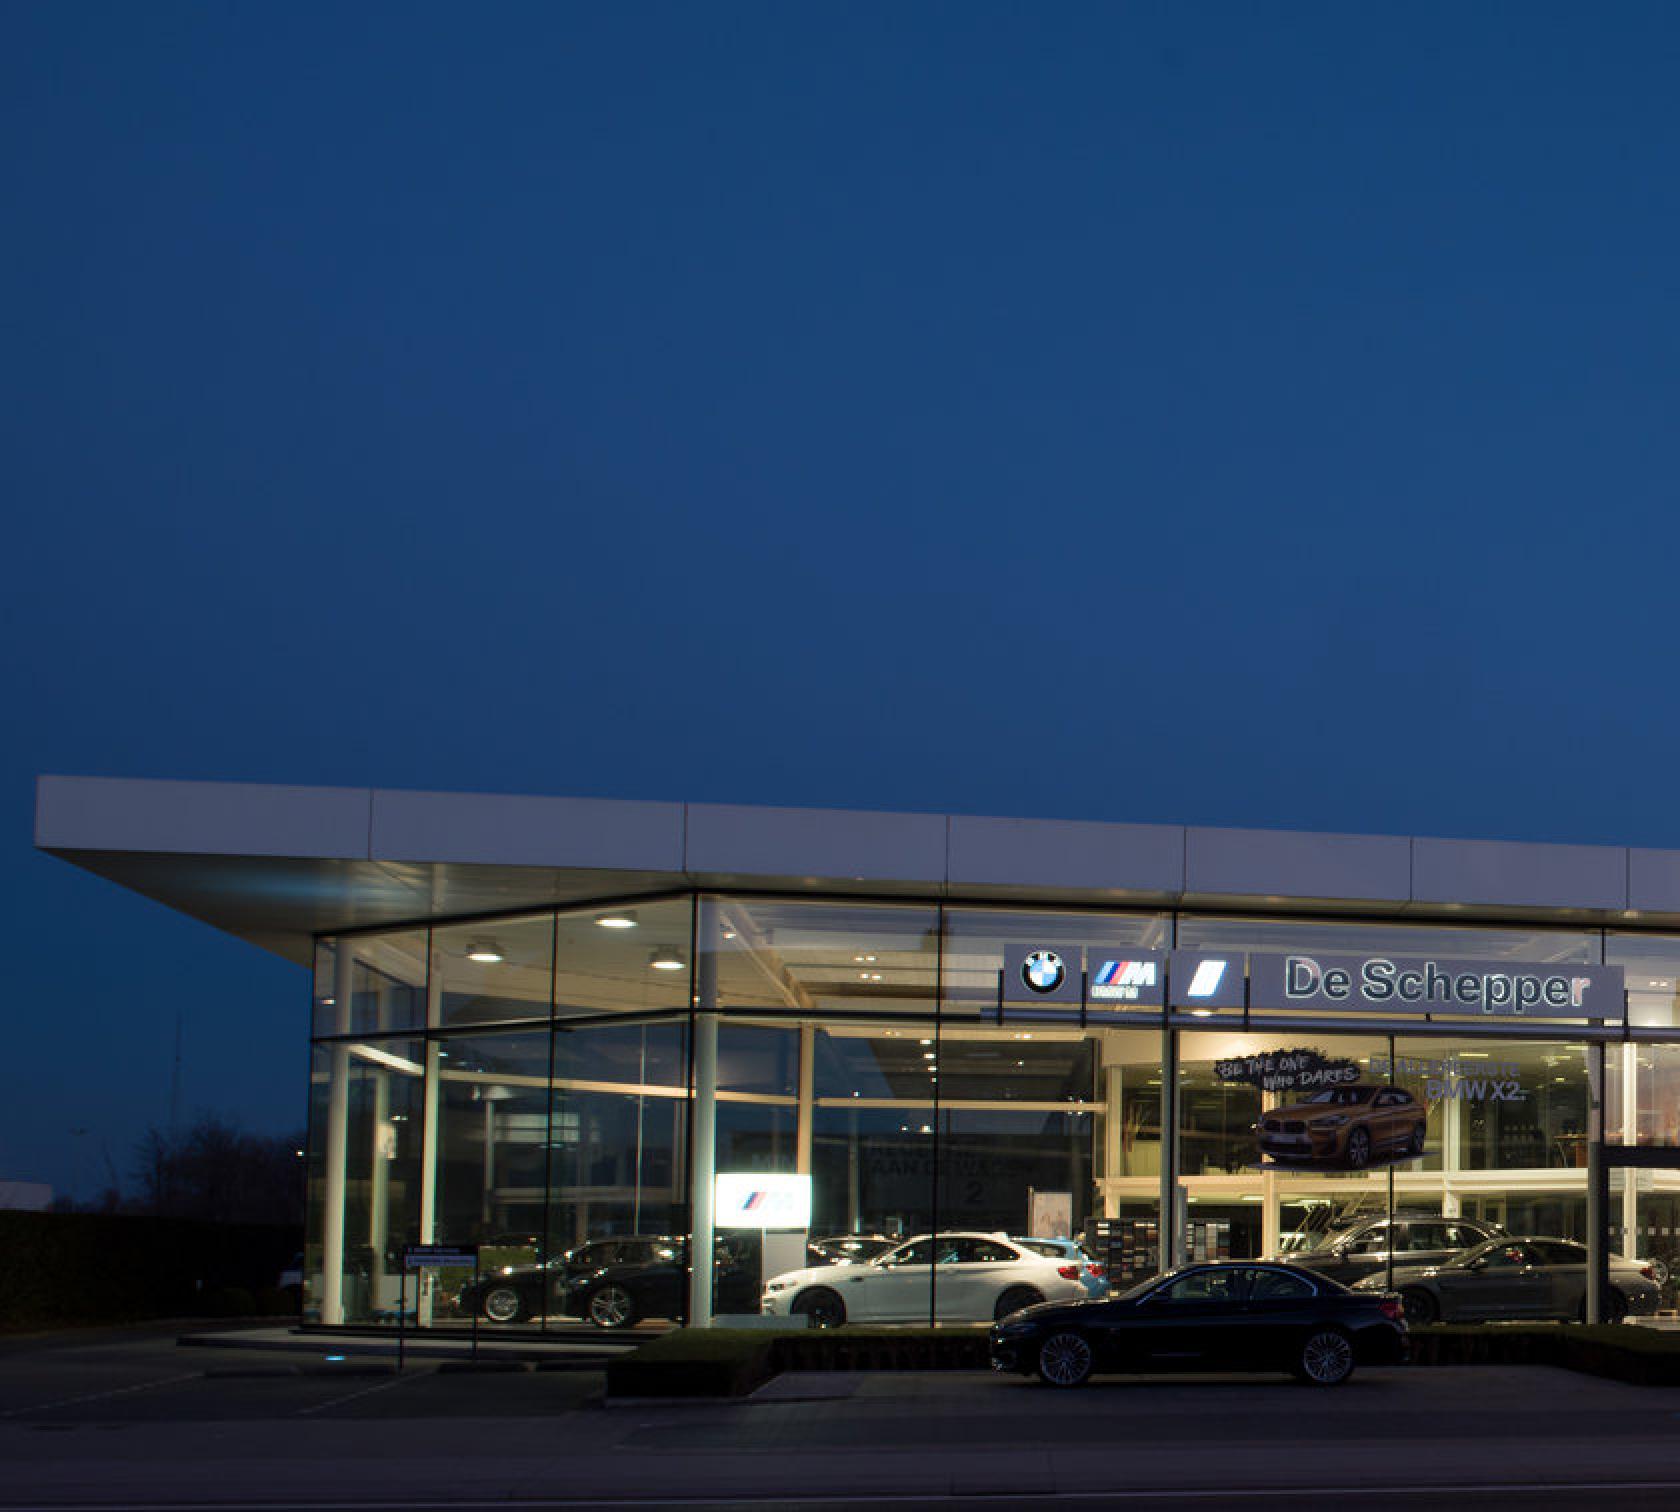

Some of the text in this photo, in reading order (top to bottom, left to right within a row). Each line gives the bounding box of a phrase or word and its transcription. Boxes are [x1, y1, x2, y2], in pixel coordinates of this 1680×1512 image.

[1285, 956, 1592, 1014] De Schepper
[1218, 1055, 1310, 1077] BE THE ONE
[1427, 1079, 1487, 1100] BMW
